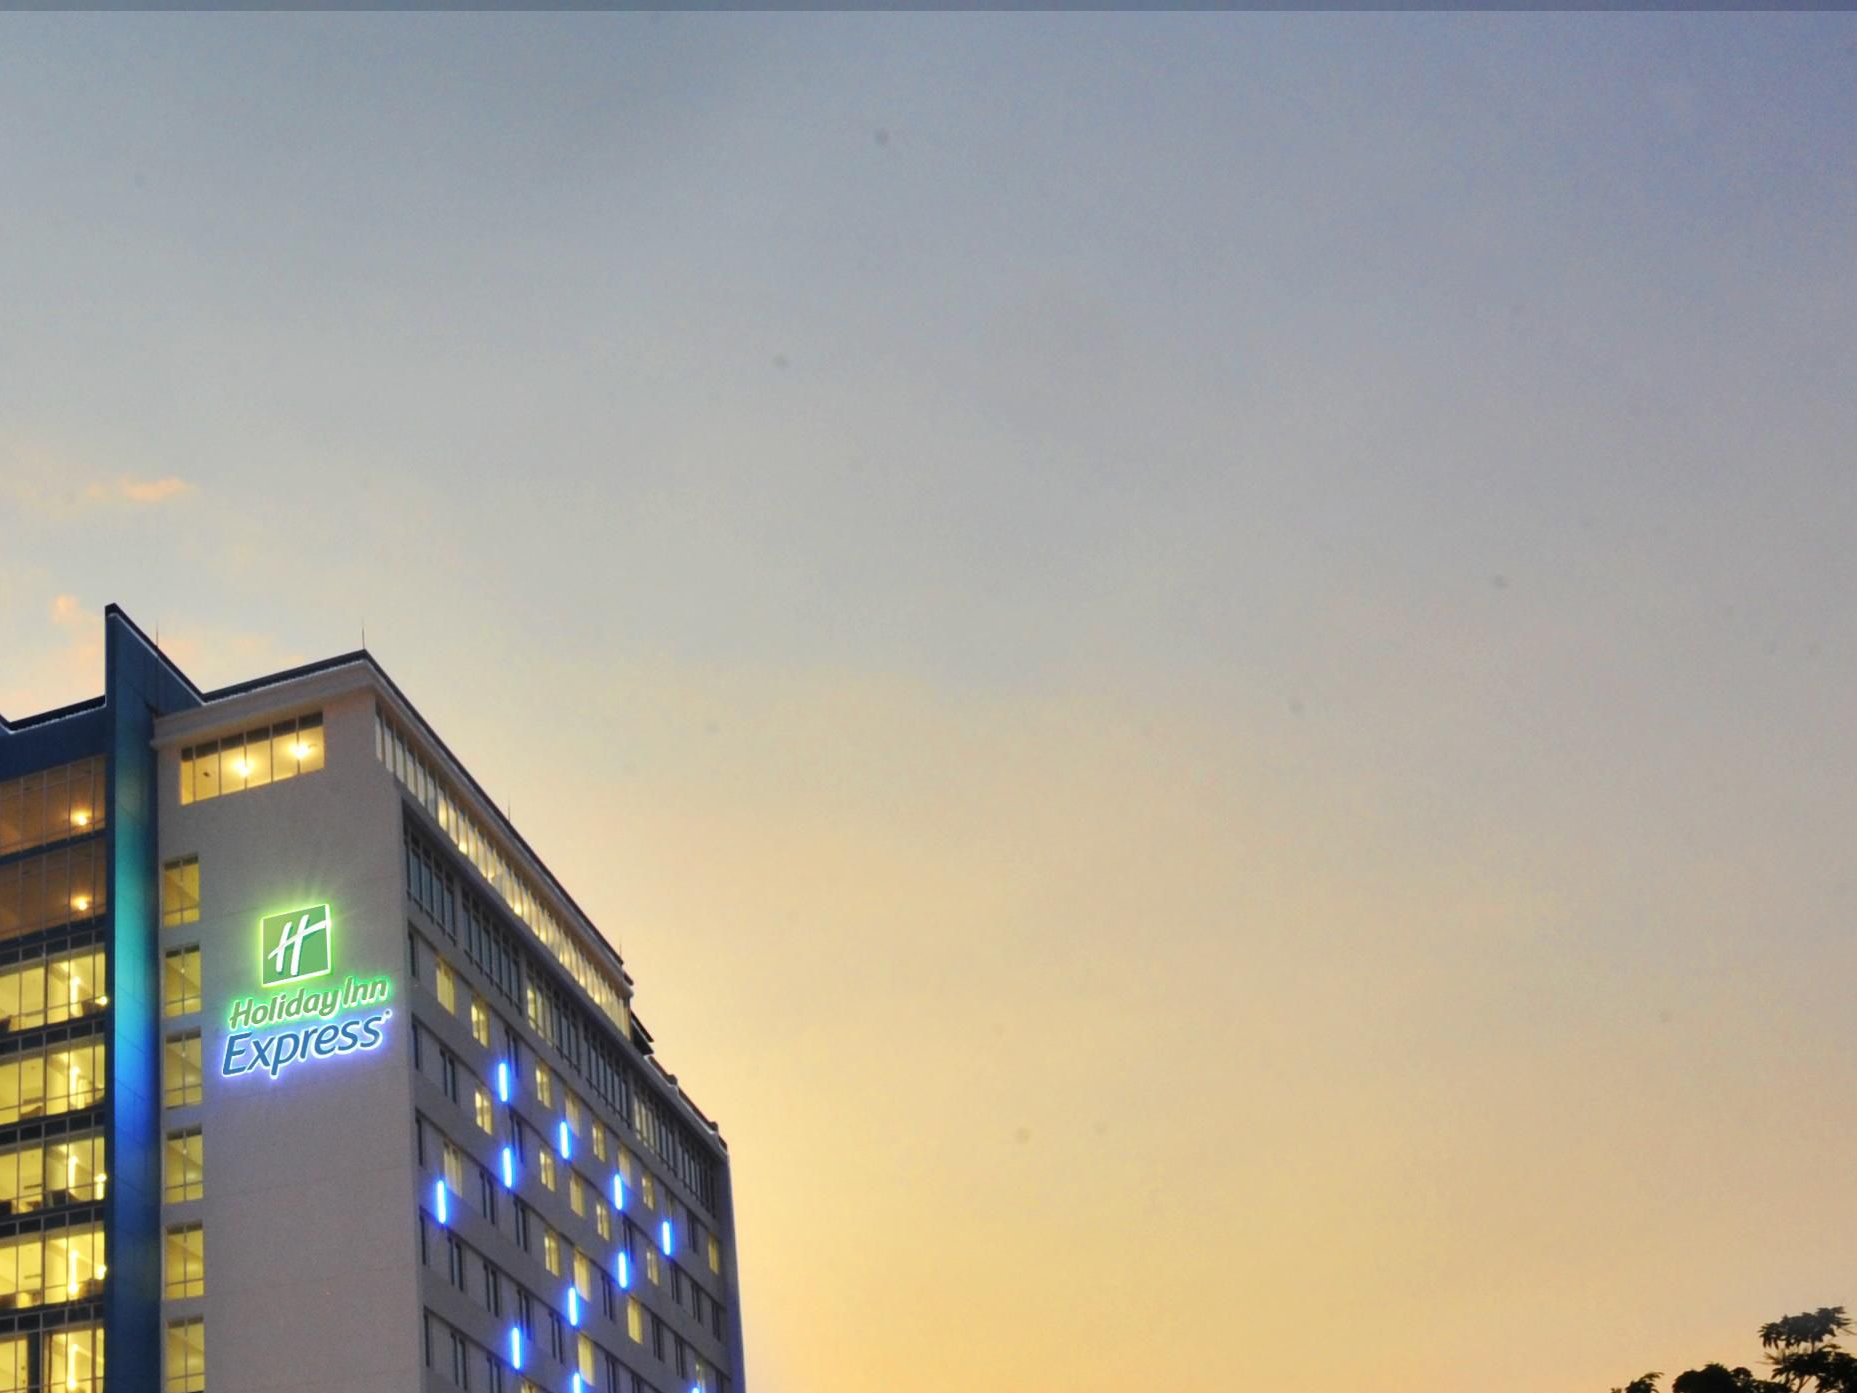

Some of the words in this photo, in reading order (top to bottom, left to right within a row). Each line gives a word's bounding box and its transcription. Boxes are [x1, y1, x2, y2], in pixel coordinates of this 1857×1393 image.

[228, 987, 340, 1030] Holiday
[342, 976, 389, 1008] Inn
[221, 1012, 387, 1078] Express
